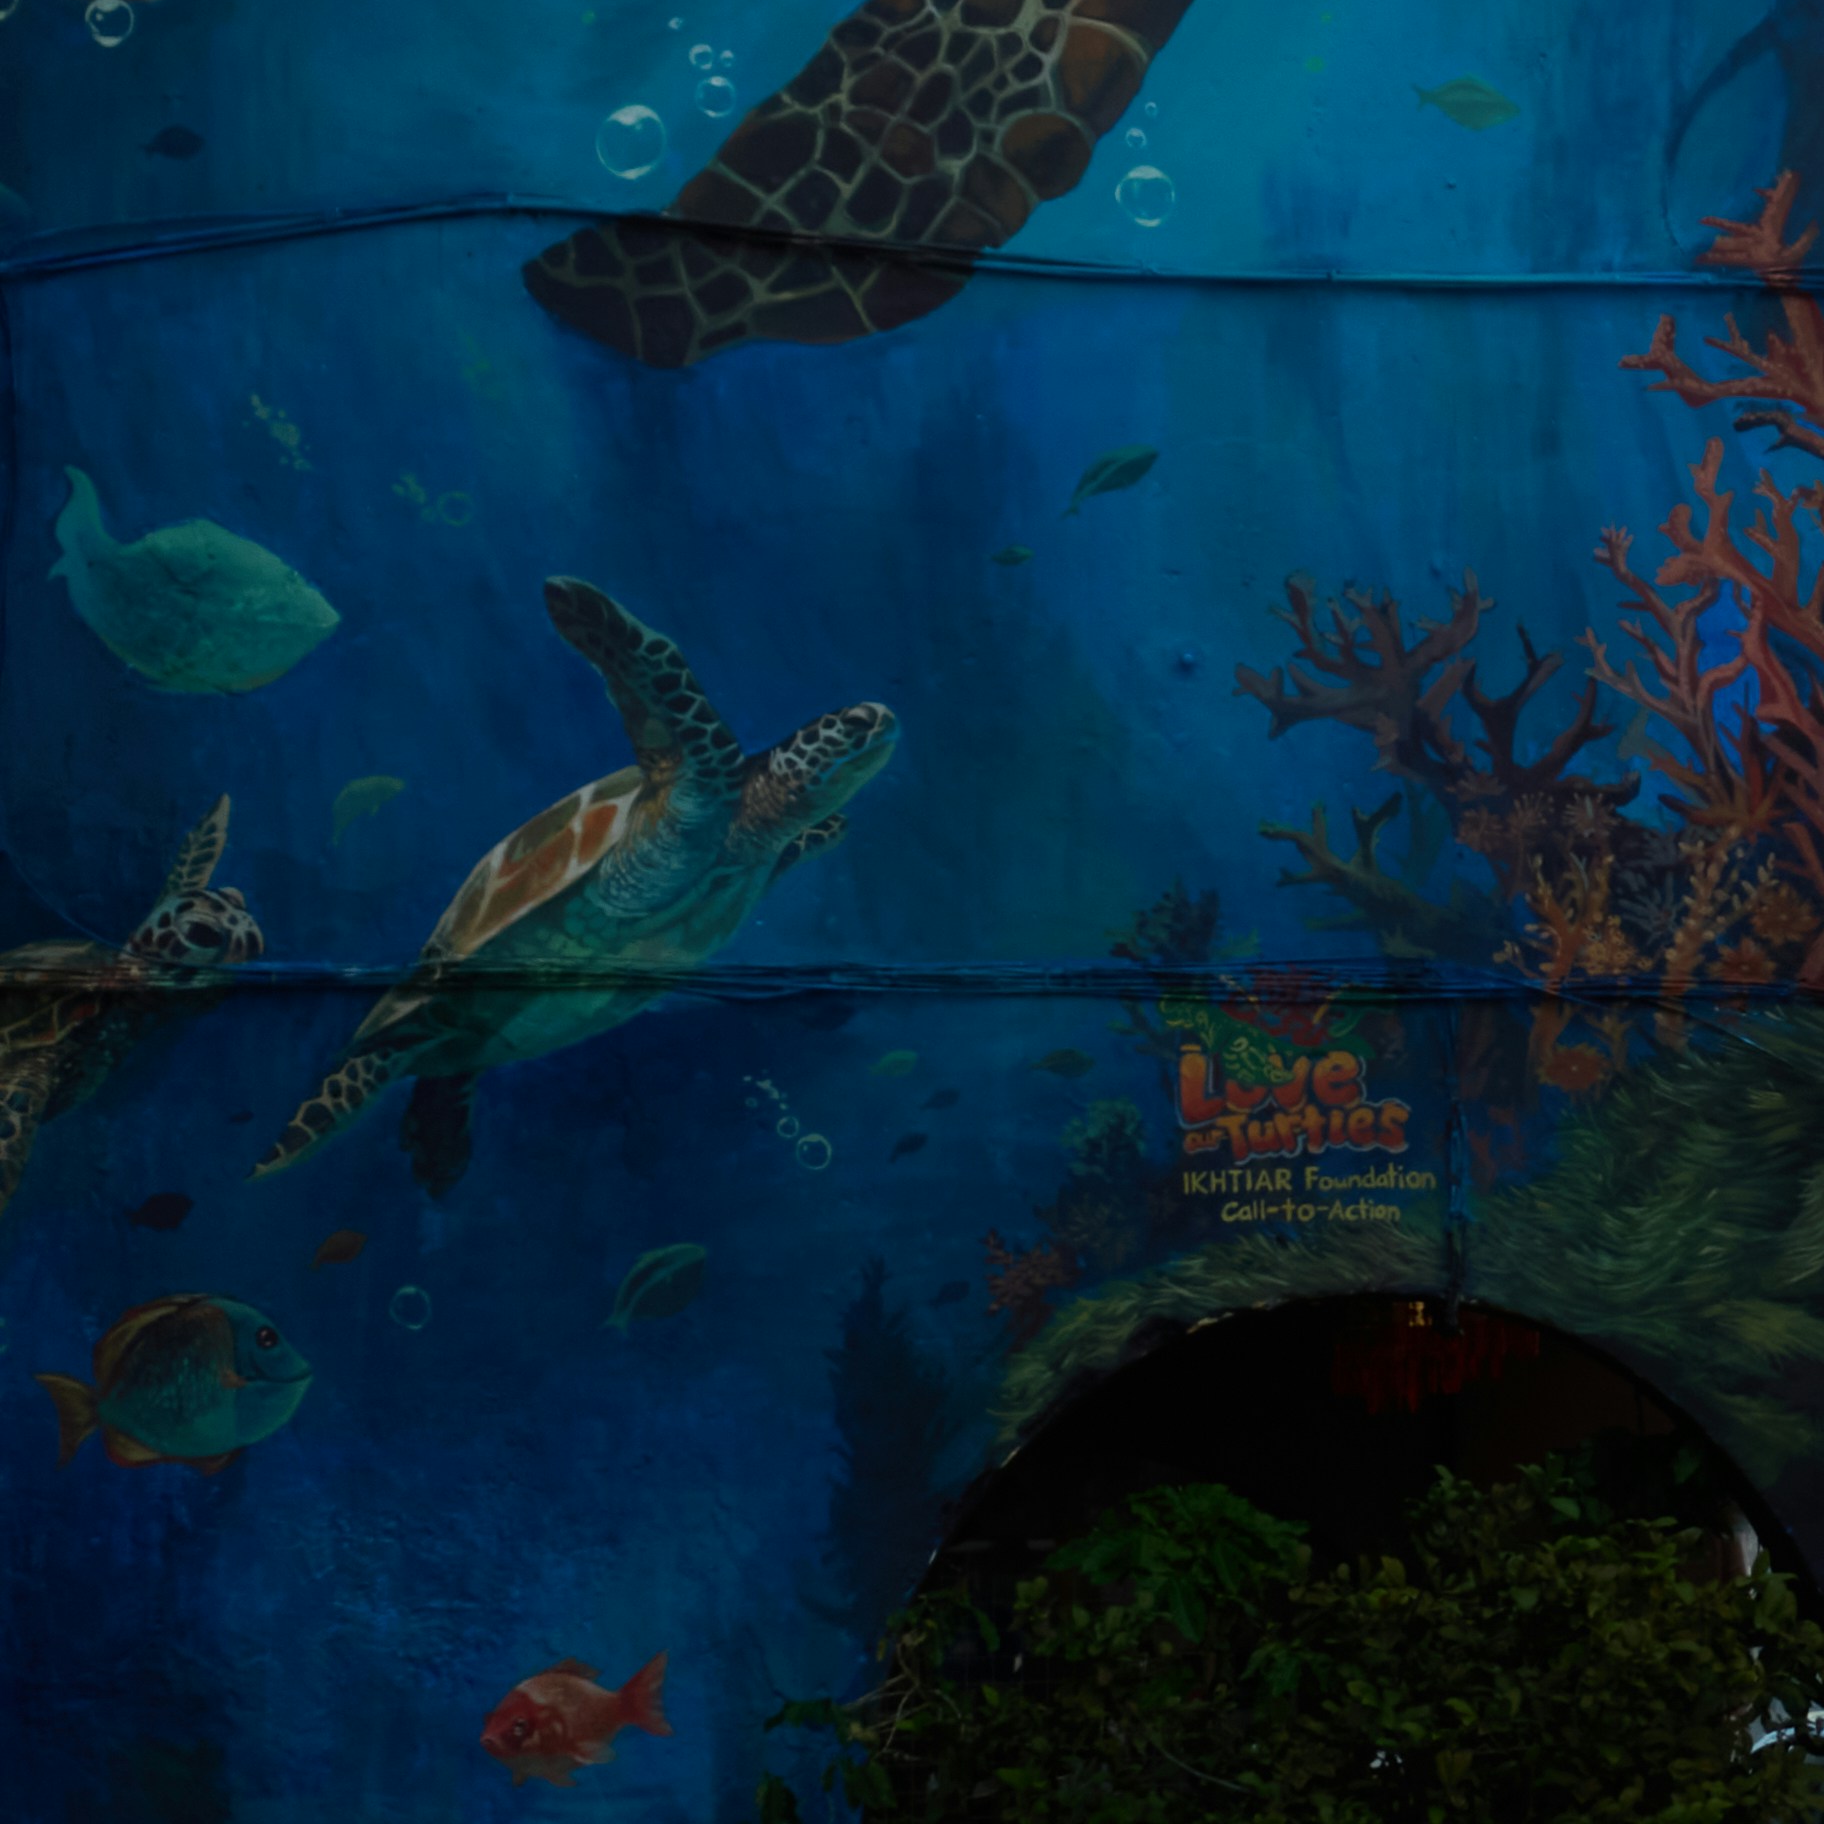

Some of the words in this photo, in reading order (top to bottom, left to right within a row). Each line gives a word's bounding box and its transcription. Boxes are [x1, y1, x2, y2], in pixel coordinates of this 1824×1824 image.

[1216, 1101, 1411, 1163] Turtles
[1183, 1168, 1292, 1194] IKHTIAR
[1304, 1163, 1437, 1191] Foundation
[1221, 1199, 1401, 1222] Call-to-Action
